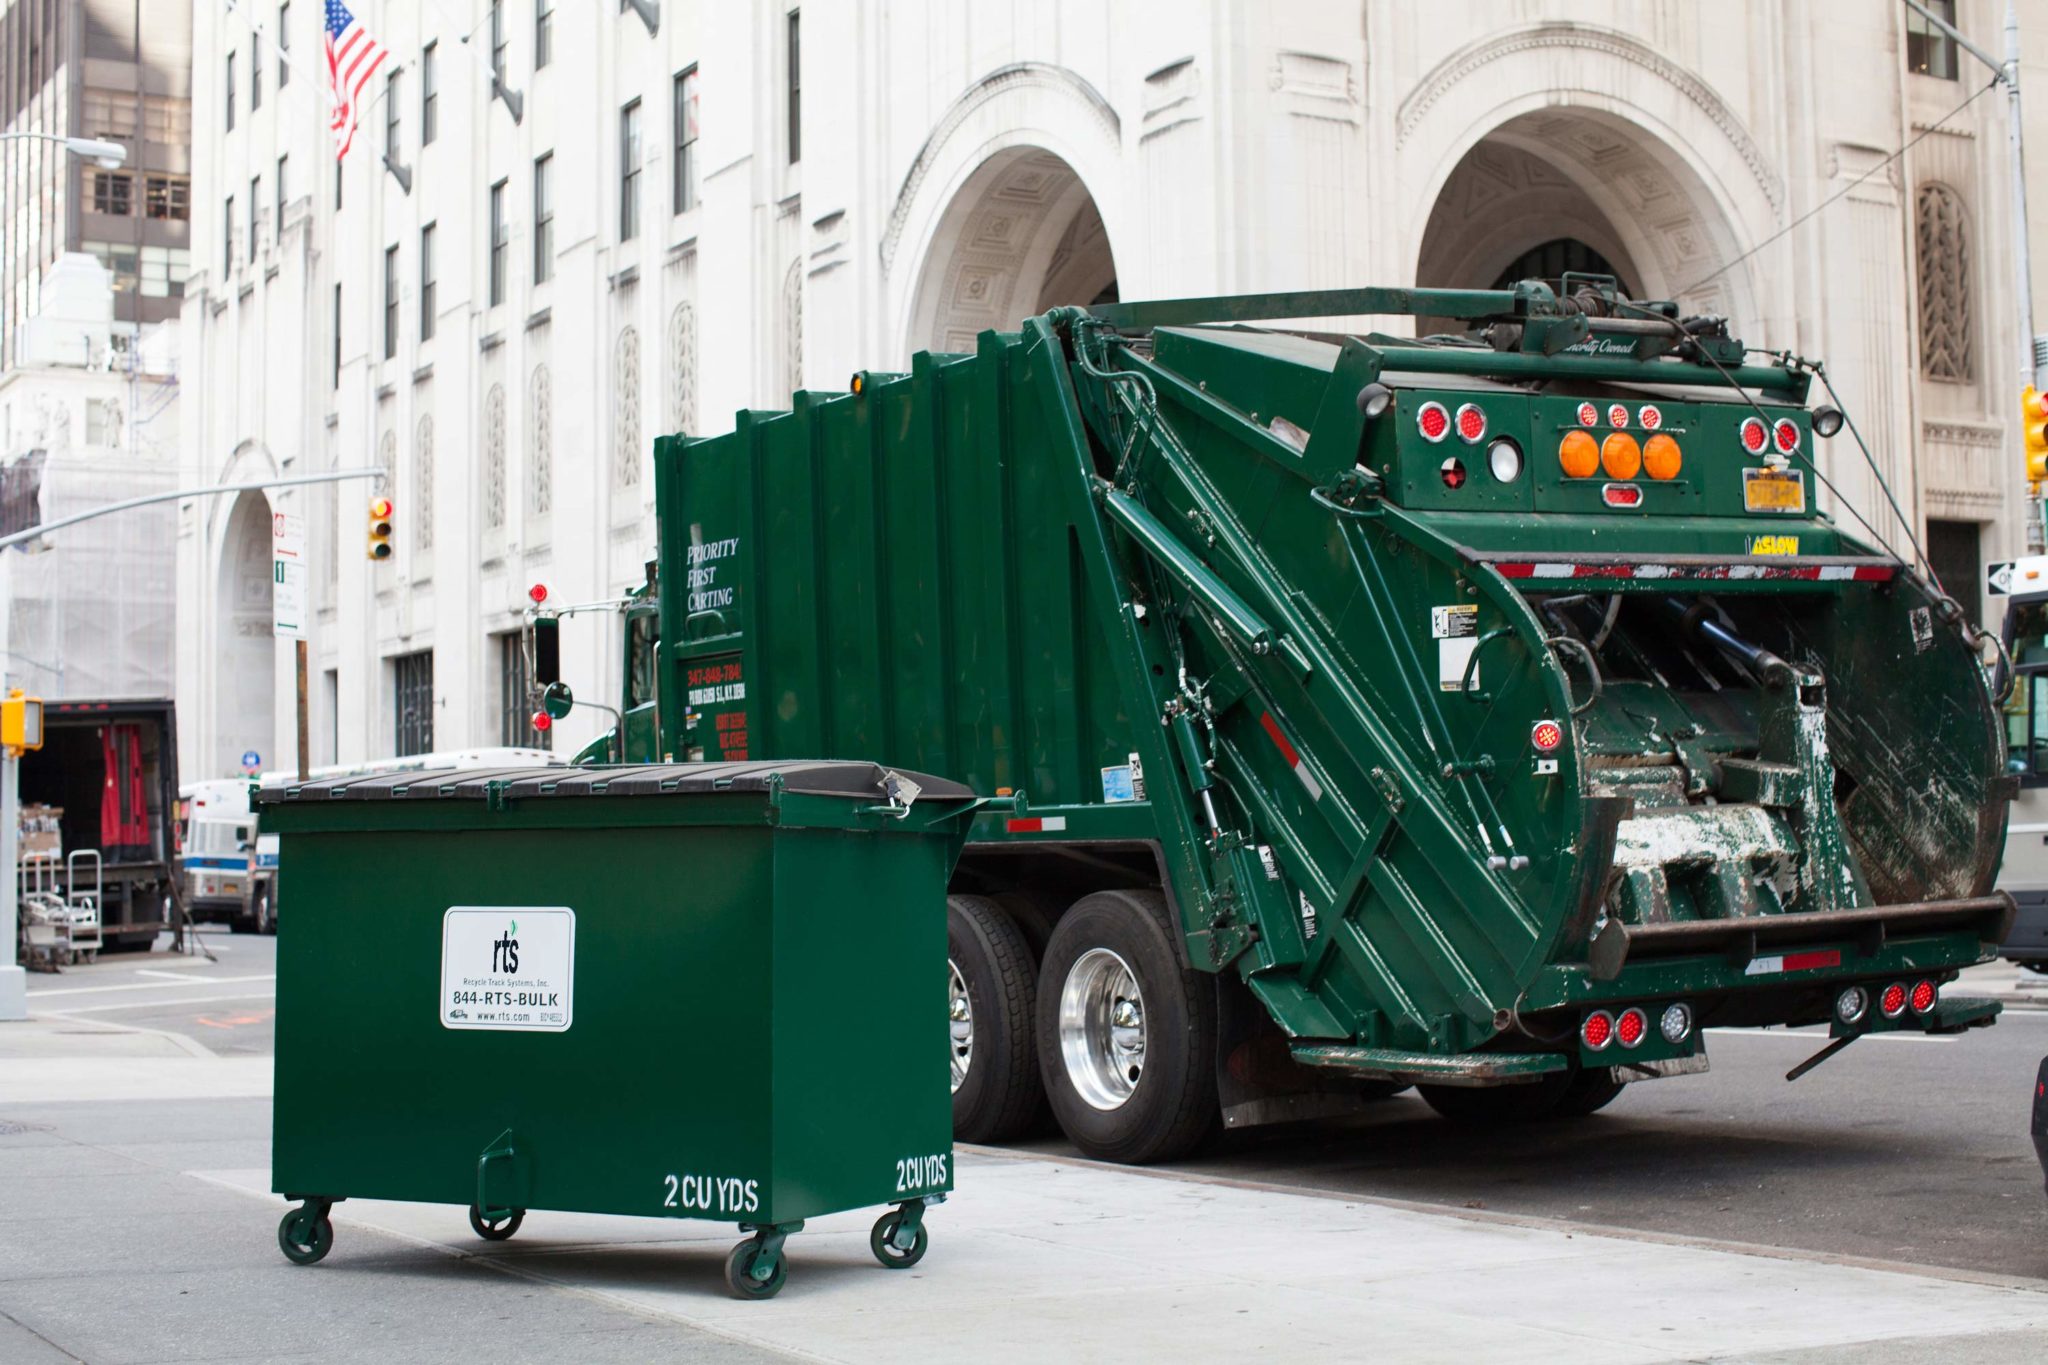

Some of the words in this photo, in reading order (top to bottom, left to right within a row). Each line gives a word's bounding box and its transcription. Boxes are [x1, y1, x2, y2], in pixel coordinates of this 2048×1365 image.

[1600, 338, 1637, 353] Owned
[687, 538, 739, 565] PRIORITY
[687, 566, 716, 588] FIRST
[688, 587, 733, 612] CARTING
[493, 930, 519, 974] rts
[463, 978, 487, 987] Recycle
[488, 978, 505, 987] Track
[453, 991, 558, 1006] 844-RTS-BULK
[477, 1012, 530, 1022] www.rts.com
